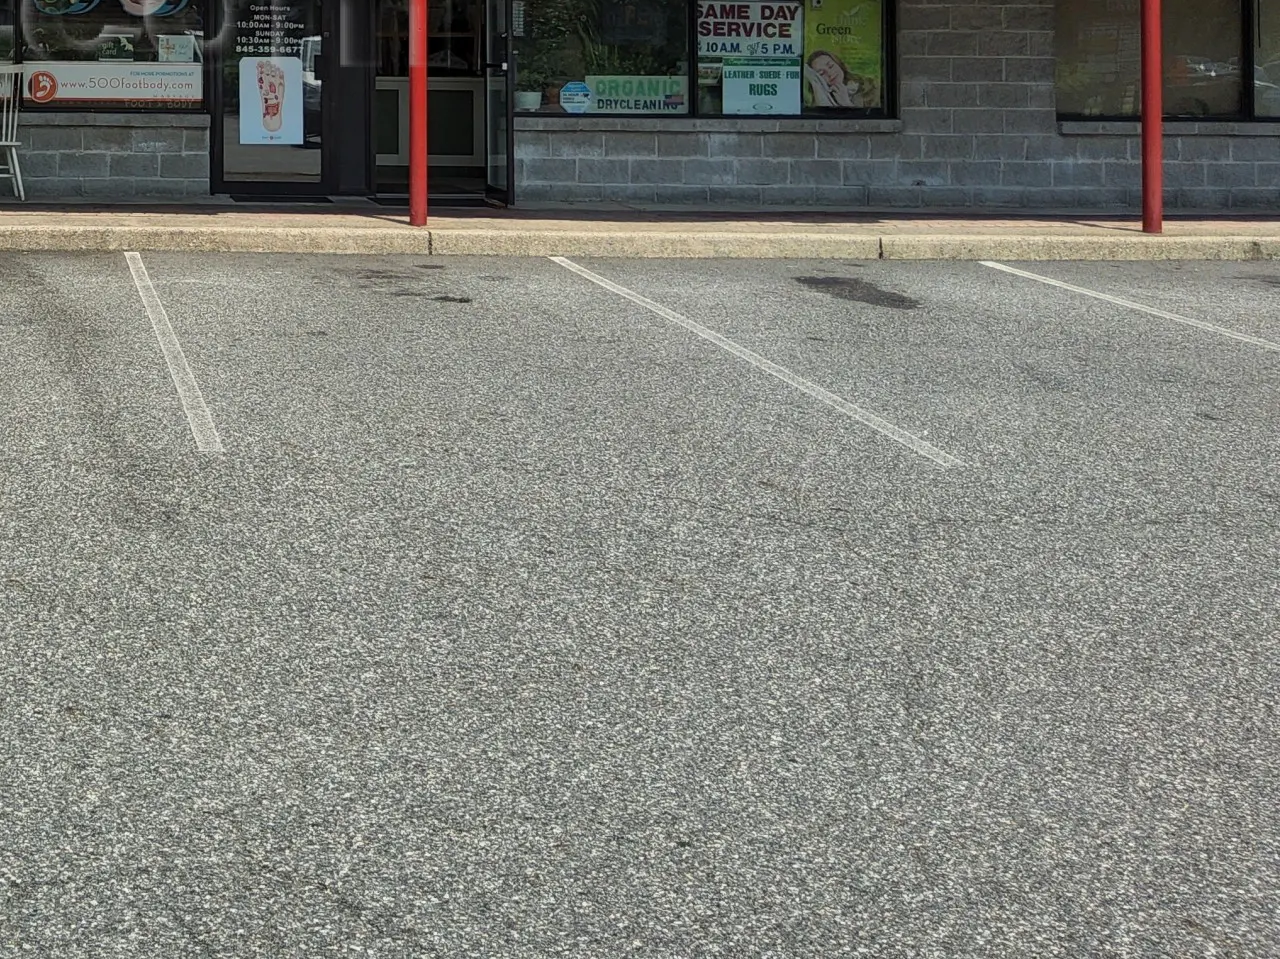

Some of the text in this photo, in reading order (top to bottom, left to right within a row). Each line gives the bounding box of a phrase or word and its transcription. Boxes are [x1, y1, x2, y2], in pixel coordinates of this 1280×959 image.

[697, 4, 799, 21] SAME DAY
[698, 21, 792, 38] SERVICE
[816, 23, 851, 35] Green
[102, 48, 117, 56] card
[235, 45, 304, 53] 845-359-6677
[706, 42, 718, 52] 10
[720, 42, 742, 53] A.M.
[761, 44, 768, 54] 5
[773, 44, 795, 55] P.M.
[724, 71, 799, 79] LEATHER SUEDE FUR
[61, 77, 193, 91] www.500footbody.com
[595, 79, 680, 97] ORGANIC
[749, 84, 777, 96] RUGS
[597, 99, 678, 110] DRYCLEANING
